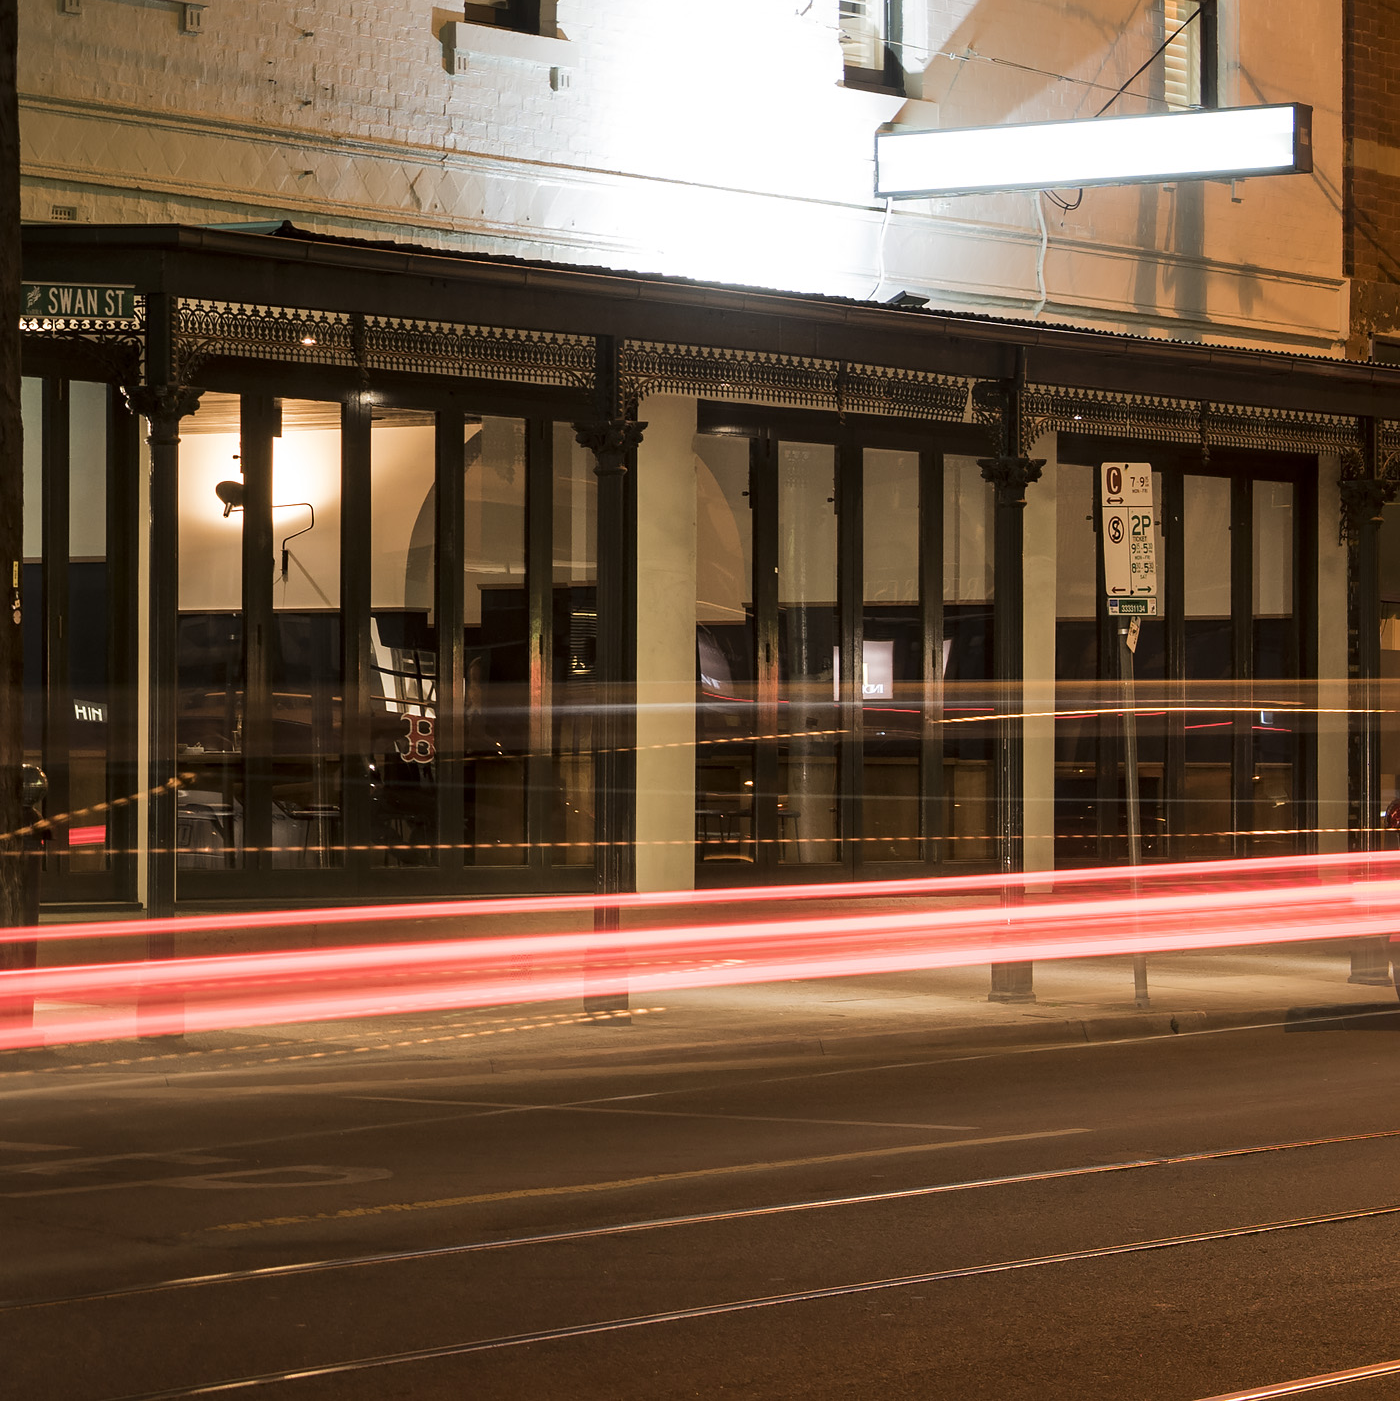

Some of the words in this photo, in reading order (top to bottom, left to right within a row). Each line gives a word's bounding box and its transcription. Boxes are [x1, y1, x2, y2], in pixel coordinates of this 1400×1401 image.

[48, 287, 98, 315] SWAN
[105, 289, 125, 316] ST
[1131, 515, 1152, 536] 2P
